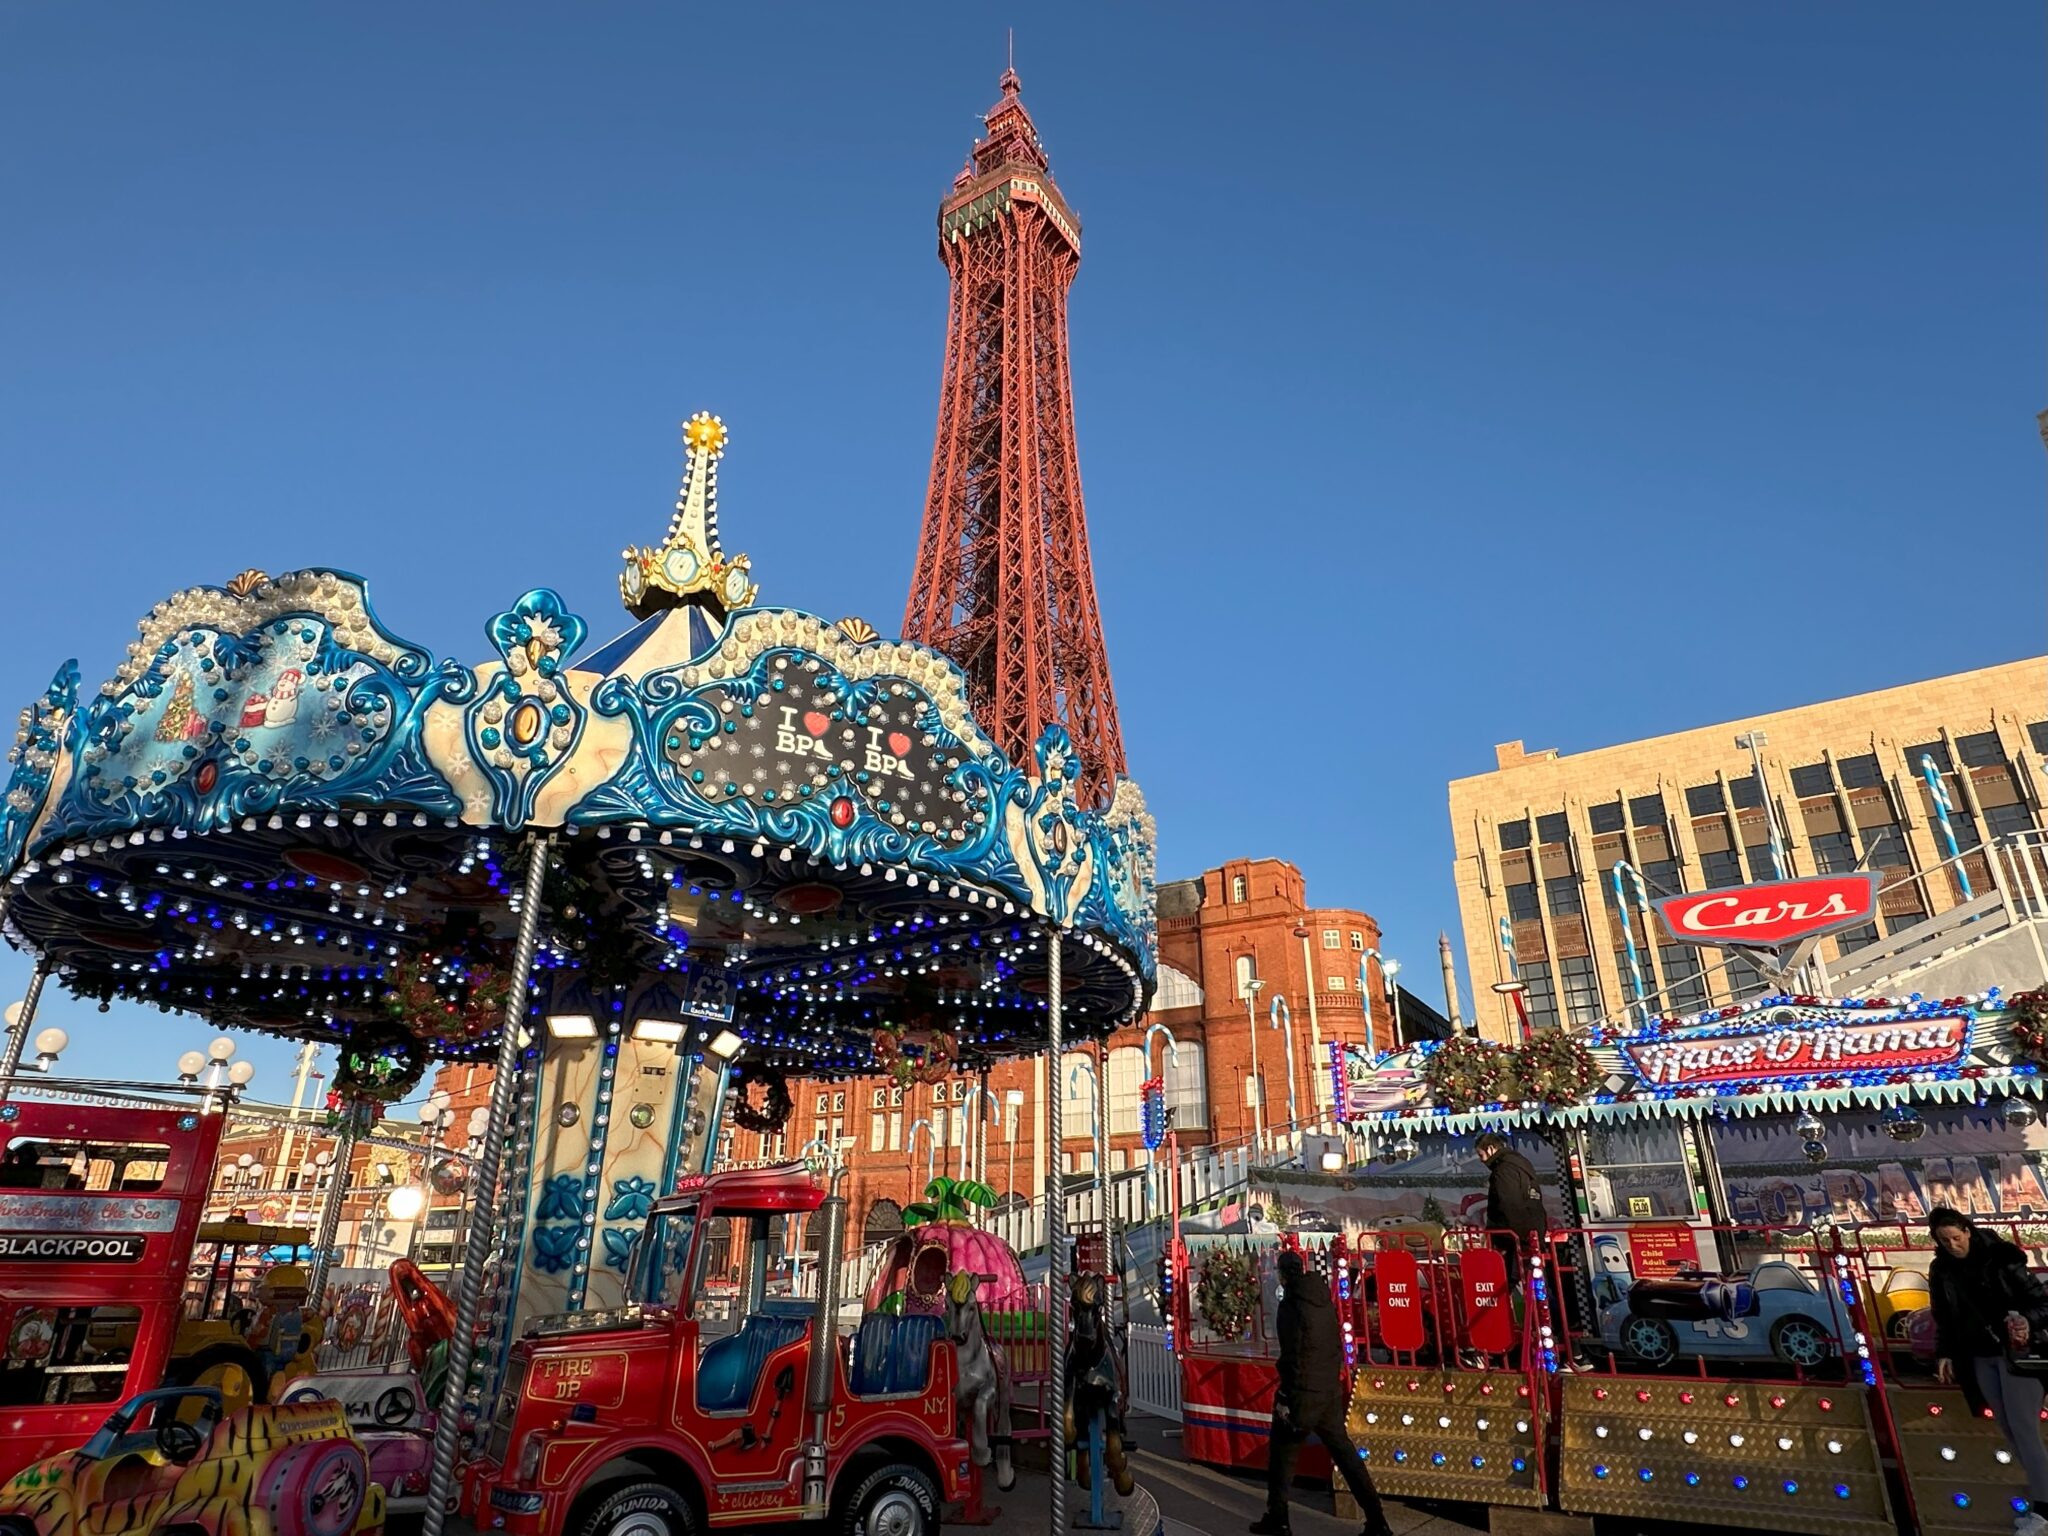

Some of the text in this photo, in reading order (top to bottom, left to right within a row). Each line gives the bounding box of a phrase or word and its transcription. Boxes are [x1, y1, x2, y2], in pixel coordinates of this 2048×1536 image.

[778, 706, 798, 731] I
[866, 726, 883, 751] I
[1682, 893, 1857, 931] Cars
[703, 967, 726, 978] FARE
[694, 976, 728, 1010] £3
[1639, 1041, 1757, 1083] Race
[0, 1201, 161, 1226] hristmas by the Sea
[1389, 1283, 1407, 1293] EXIT
[1475, 1282, 1494, 1292] EXIT
[1388, 1297, 1410, 1307] ONLY
[1475, 1296, 1498, 1307] ONLY
[544, 1358, 593, 1378] FIRE
[834, 1403, 847, 1427] 5
[731, 1492, 784, 1509] Mickey
[894, 1476, 933, 1514] DUNLOP
[609, 1497, 669, 1521] DUNLOP
